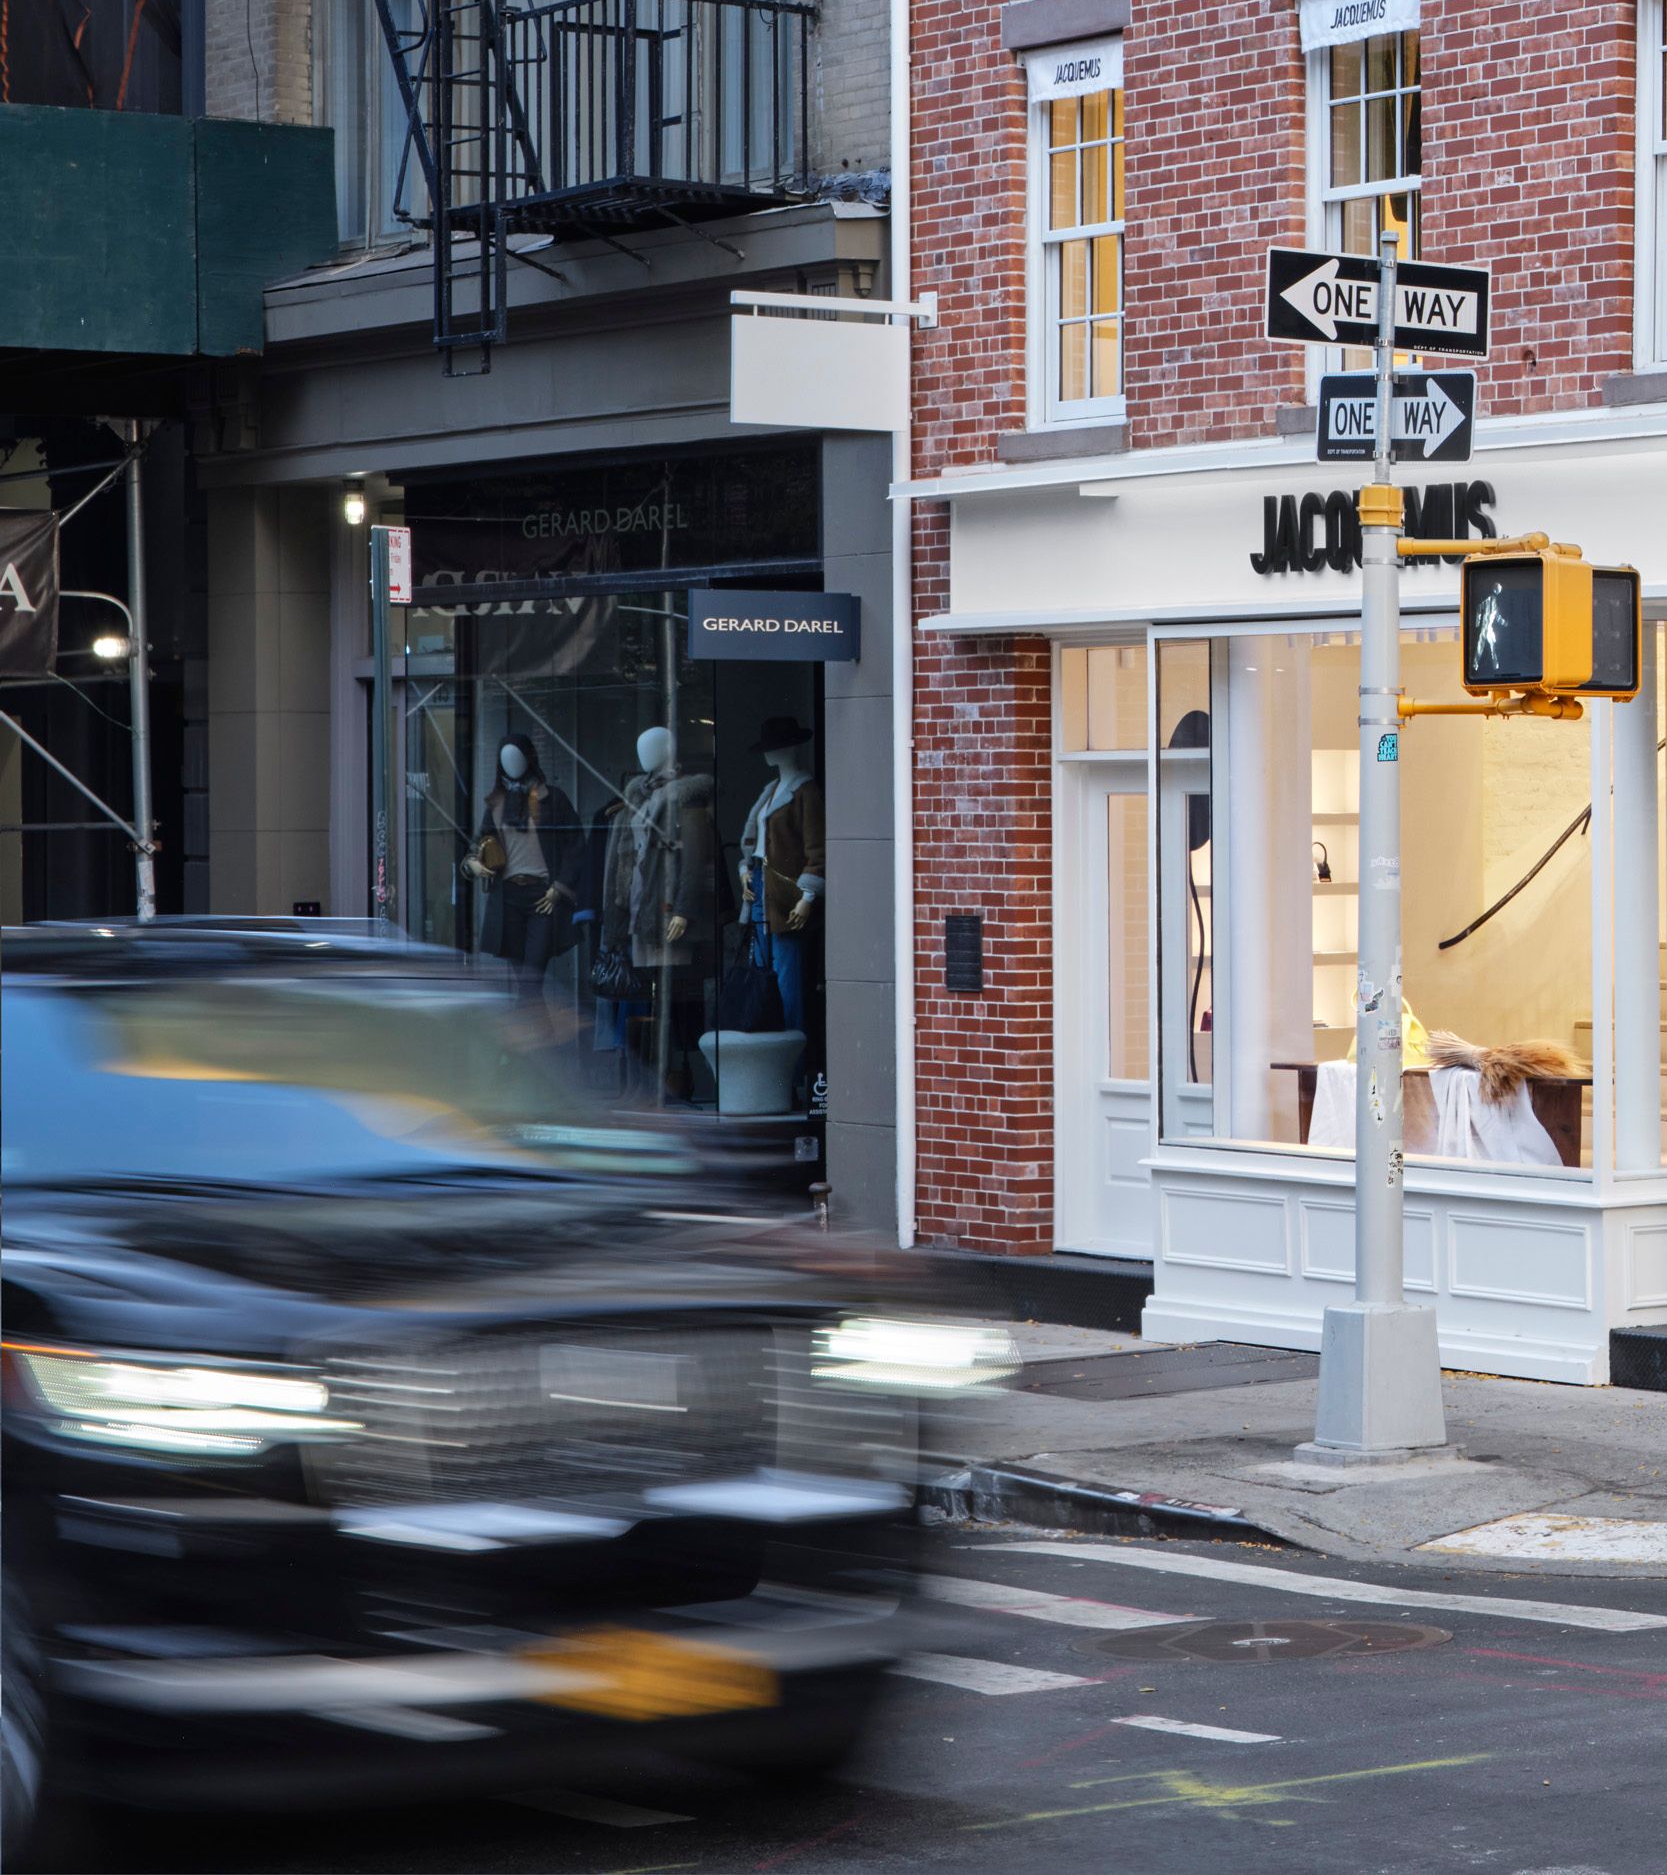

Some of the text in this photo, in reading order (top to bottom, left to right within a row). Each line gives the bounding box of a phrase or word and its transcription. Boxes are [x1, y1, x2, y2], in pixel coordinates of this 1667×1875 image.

[1053, 58, 1101, 85] JACQUEMUS
[1313, 281, 1466, 327] ONE WAY
[1438, 347, 1484, 356] TRANSPORTATION
[1335, 401, 1447, 436] ONE WAY
[522, 503, 689, 539] GERARD DAREL
[703, 617, 844, 634] GERARD DAREL
